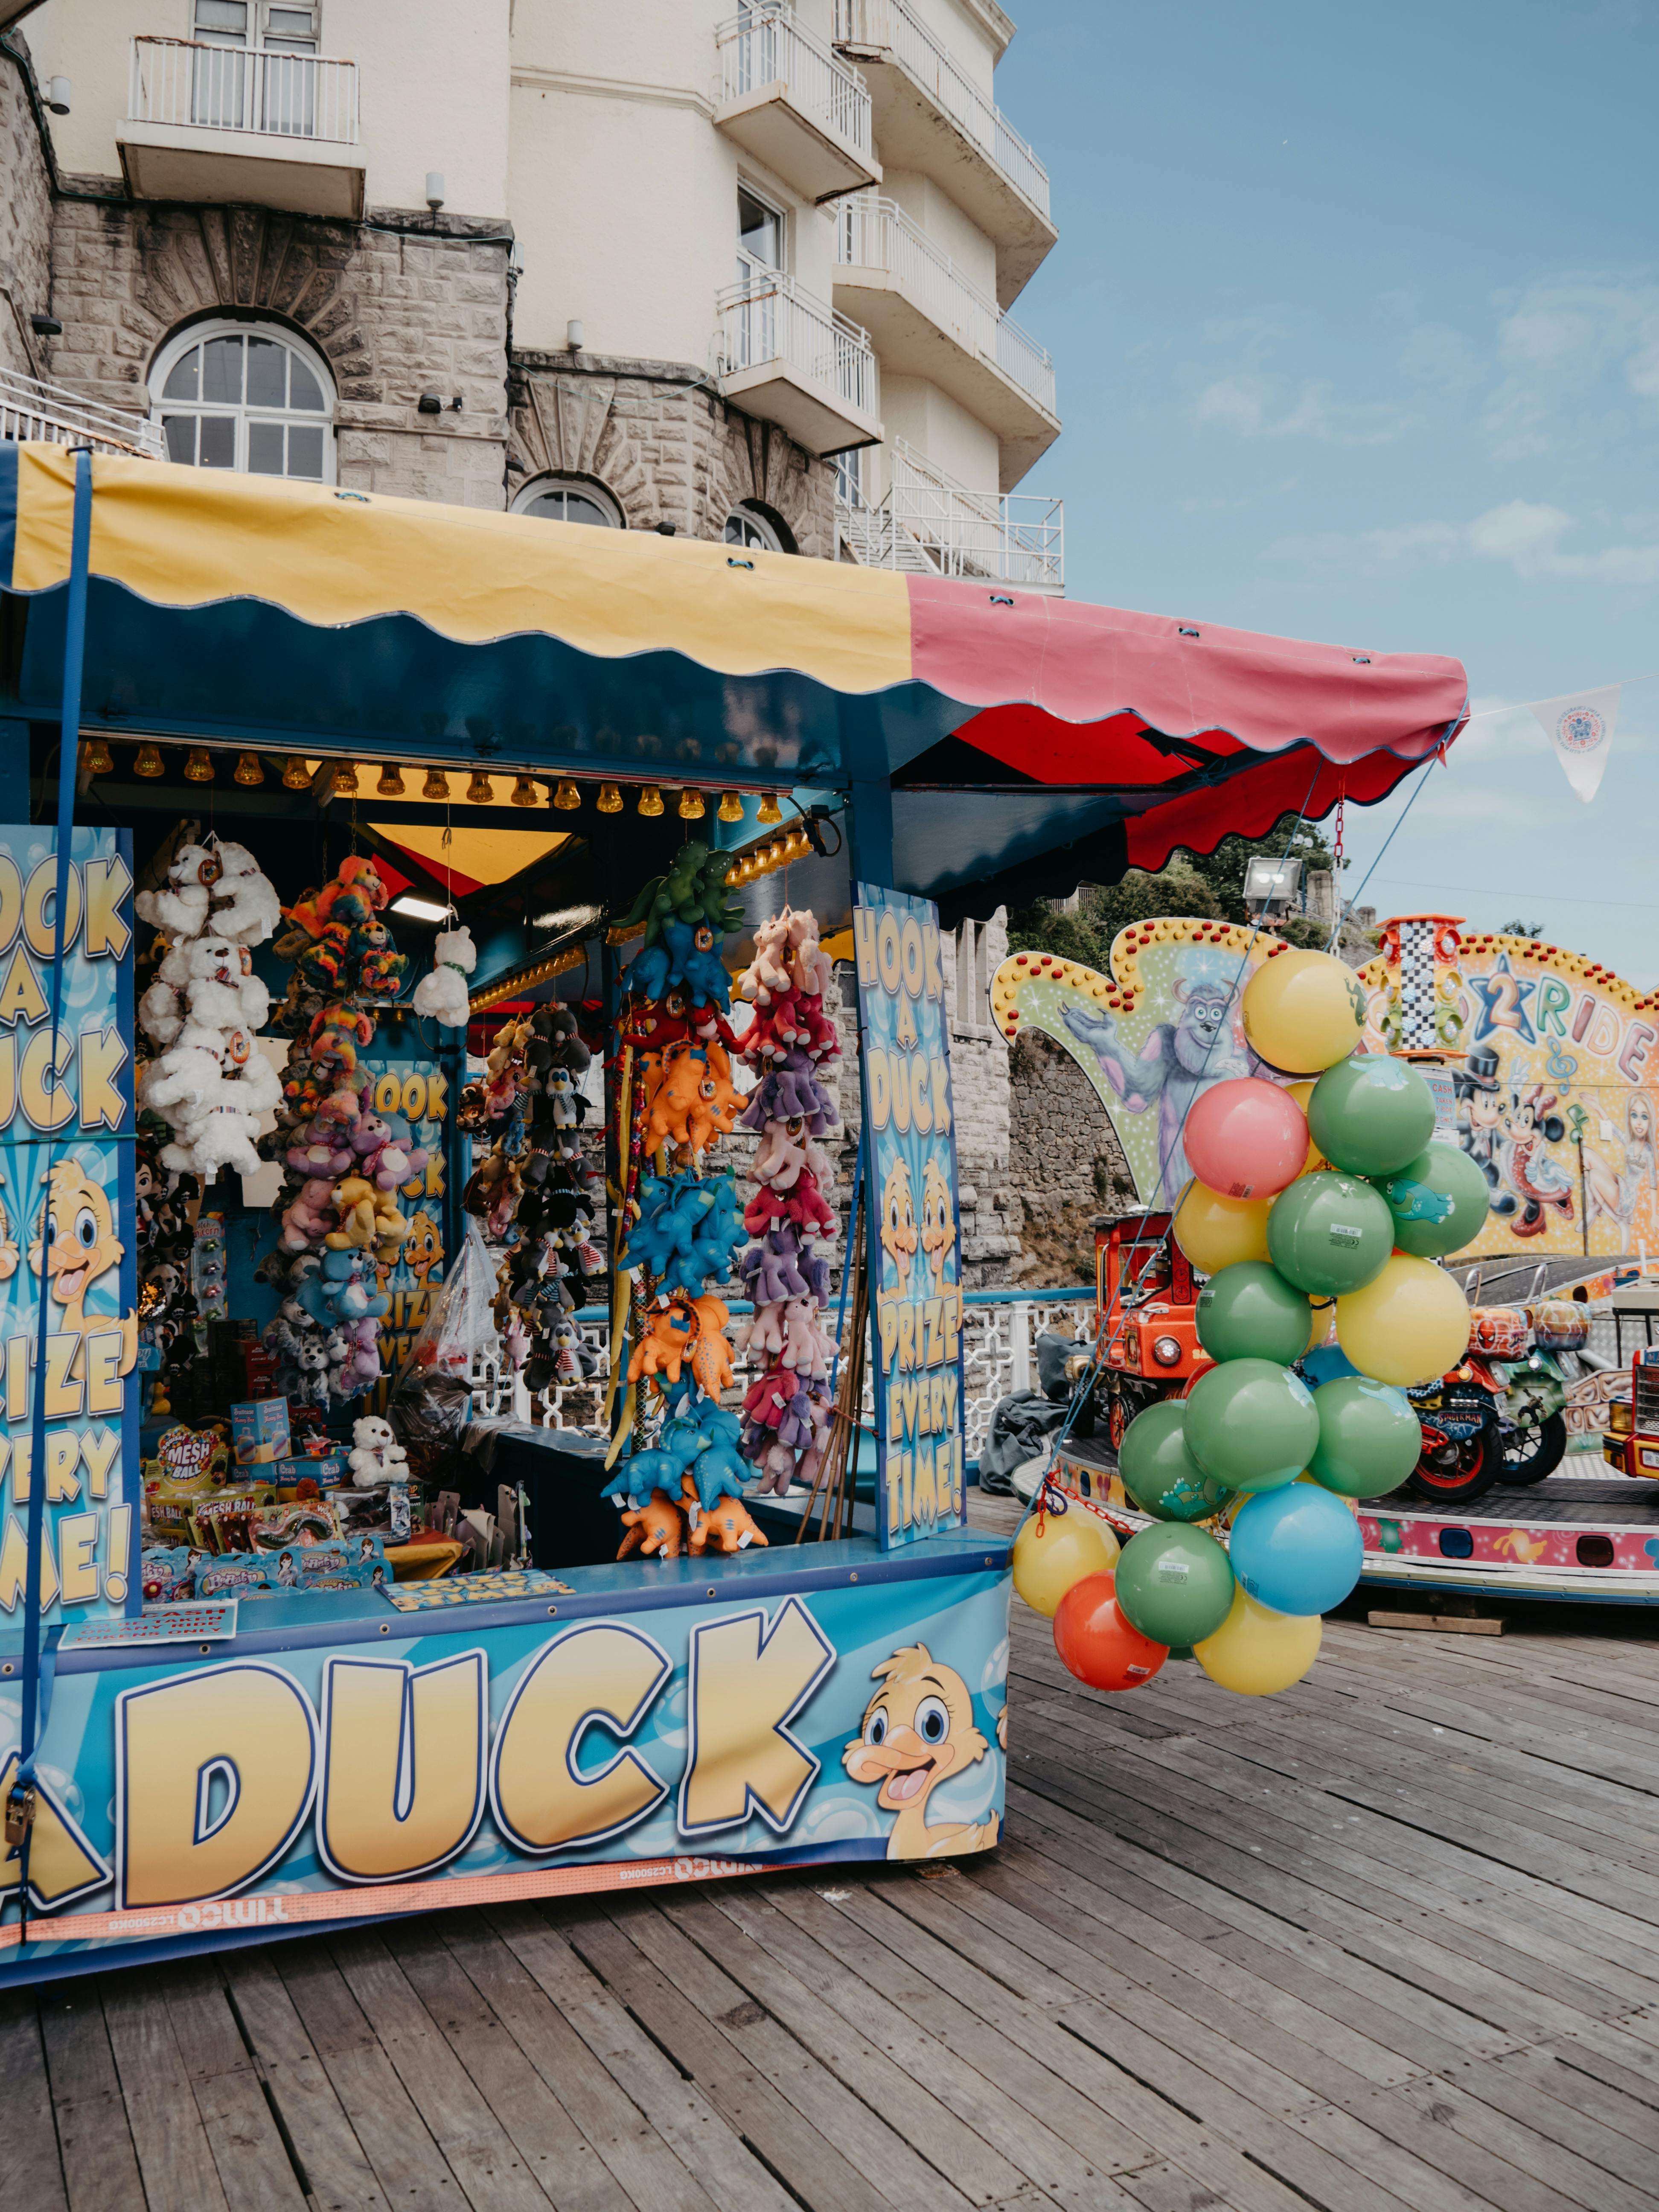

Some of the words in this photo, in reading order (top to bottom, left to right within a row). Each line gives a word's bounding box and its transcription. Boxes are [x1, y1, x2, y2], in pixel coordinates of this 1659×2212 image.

[853, 905, 943, 1004] HOOK
[896, 982, 918, 1050] A
[1486, 971, 1522, 1029] 2
[1537, 975, 1654, 1081] RIDE
[0, 1025, 128, 1131] CK
[370, 1072, 448, 1122] OOK
[867, 1046, 951, 1136] DUCK
[1432, 1083, 1452, 1094] CASH
[880, 1295, 959, 1374] PRIZE
[0, 1330, 125, 1421] IZE
[890, 1372, 958, 1442] EVERY
[1439, 1412, 1481, 1425] SPIDERMAN
[162, 1435, 186, 1450] SQUISHY
[168, 1443, 210, 1464] MESH
[0, 1427, 121, 1502] ERY
[172, 1464, 202, 1479] BALL
[234, 1468, 249, 1478] Crab
[280, 1463, 296, 1475] Crab
[322, 1462, 340, 1476] Crab
[886, 1432, 963, 1535] TIME!
[151, 1506, 165, 1518] ESH
[166, 1507, 183, 1520] BALL
[234, 1499, 256, 1512] BALL
[302, 1555, 340, 1572] eauty
[399, 1571, 531, 1591] PRIZE
[420, 1578, 530, 1596] EVERY
[140, 1609, 226, 1618] CASH
[74, 1632, 160, 1641] TOKENS
[114, 1597, 837, 1910] DUCK
[620, 1865, 672, 1880] LC2500KG
[108, 1914, 175, 1930] LC2500KG
[178, 1897, 289, 1929] TIMCO
